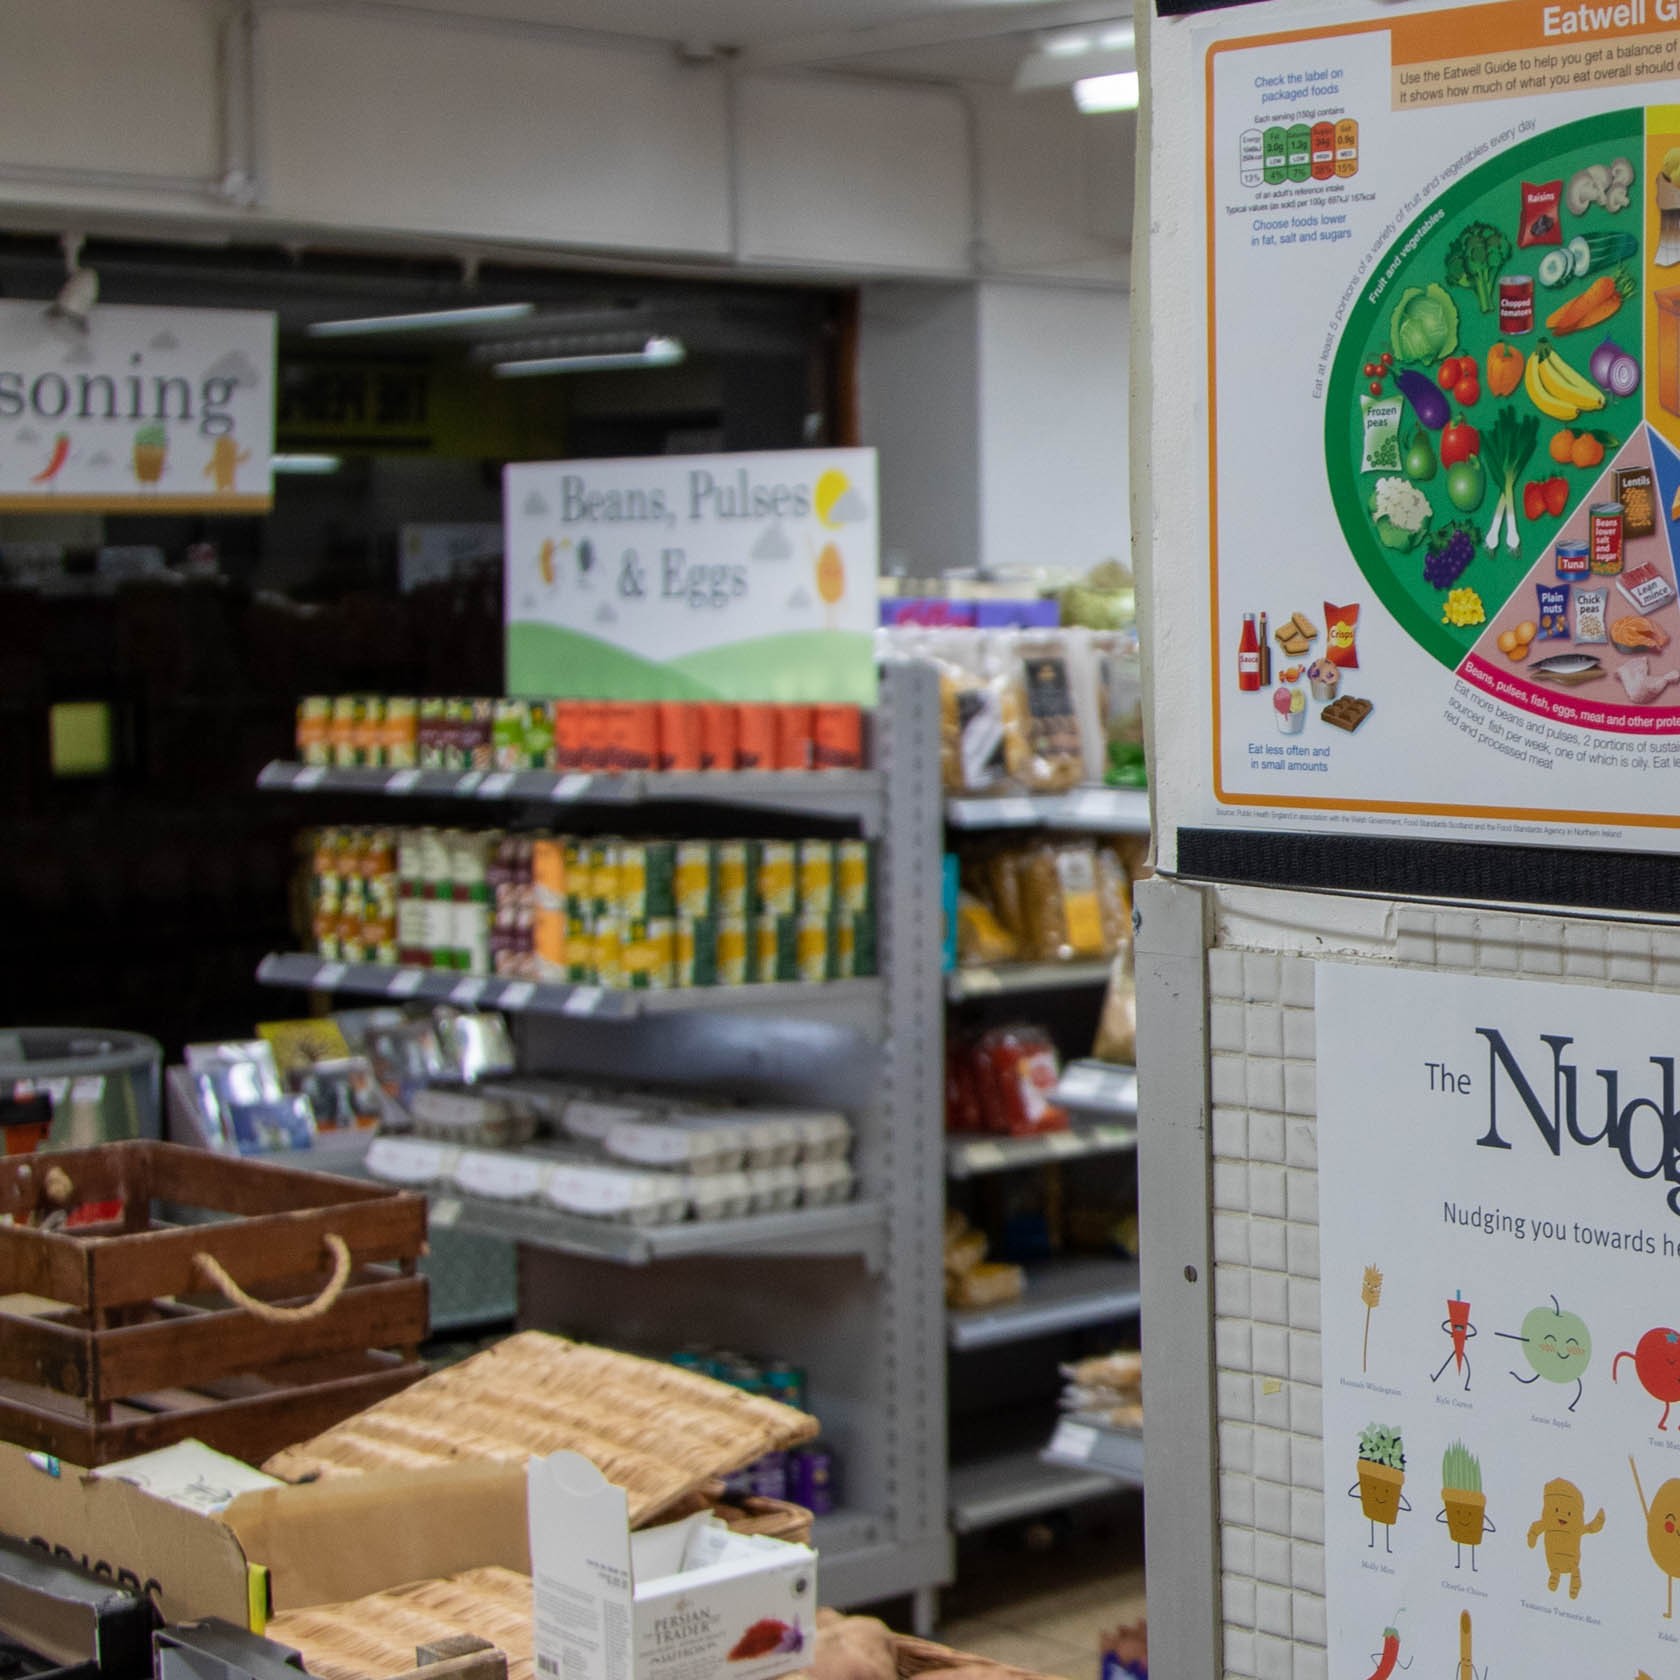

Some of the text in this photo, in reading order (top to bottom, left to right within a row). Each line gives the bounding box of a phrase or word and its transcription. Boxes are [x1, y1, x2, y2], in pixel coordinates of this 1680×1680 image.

[1400, 71, 1421, 85] Use
[1423, 69, 1441, 83] the
[1443, 63, 1482, 80] Eatwell
[1484, 60, 1517, 75] Guide
[1519, 59, 1531, 71] to
[1533, 54, 1558, 71] help
[1561, 54, 1582, 68] you
[1584, 49, 1603, 66] get
[1606, 50, 1614, 61] a
[1616, 42, 1663, 59] balance
[1665, 38, 1678, 52] of
[1254, 70, 1344, 88] Check the label on
[1261, 84, 1339, 104] packaged foods
[1527, 192, 1555, 203] Raisins
[1368, 208, 1446, 305] Fruit and vegetables
[0, 352, 239, 436] soning
[1366, 405, 1398, 418] Frozen
[1367, 418, 1389, 429] peas
[1622, 476, 1650, 488] Lentils
[561, 467, 811, 528] Beans, Pulses
[1563, 559, 1585, 569] Tuna
[617, 547, 748, 608] & Eggs
[1330, 629, 1354, 641] Crisps
[1248, 744, 1331, 757] Eat less often and
[1251, 758, 1329, 772] in small amounts
[1424, 1062, 1472, 1095] The
[1443, 1201, 1526, 1240] Nudging
[1531, 1220, 1567, 1243] you
[1573, 1222, 1656, 1255] towards
